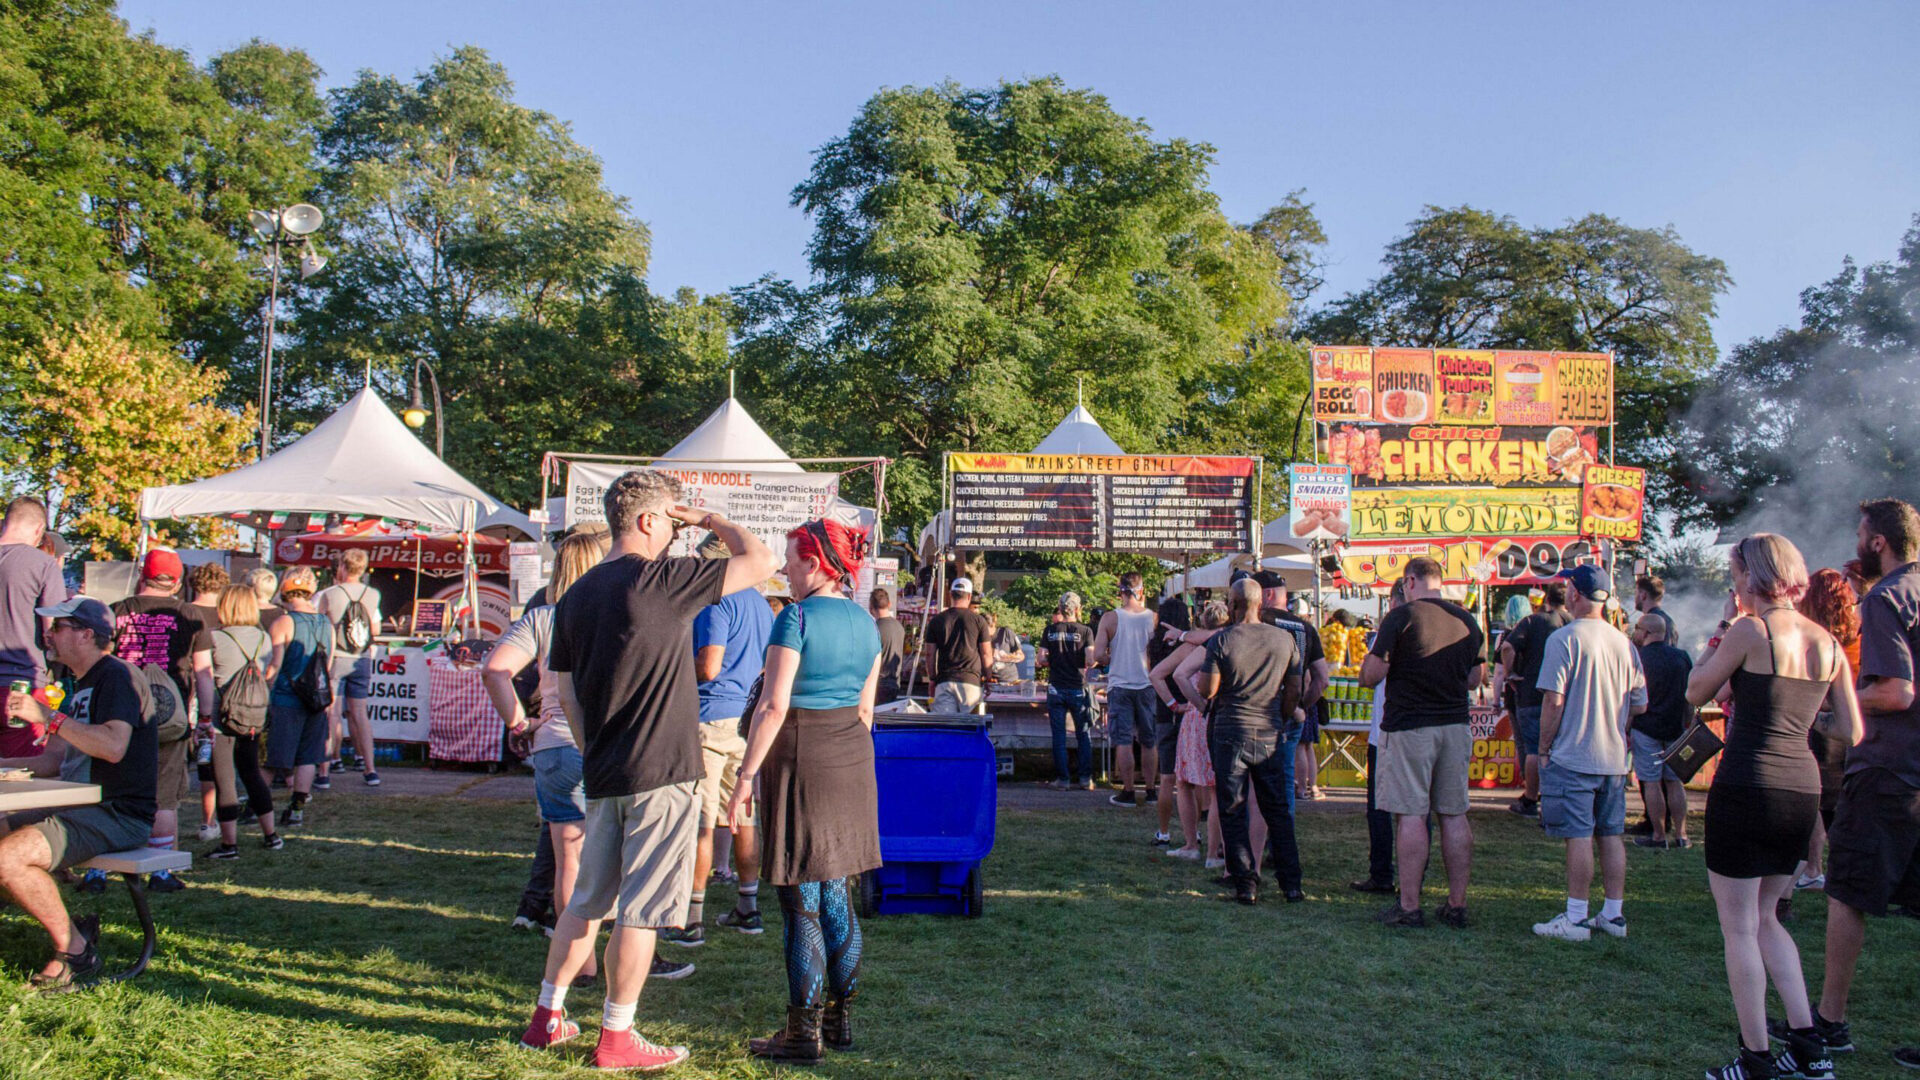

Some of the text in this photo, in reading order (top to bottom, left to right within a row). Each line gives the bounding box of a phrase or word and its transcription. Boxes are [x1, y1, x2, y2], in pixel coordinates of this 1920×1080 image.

[1437, 354, 1492, 377] Chicken
[1558, 358, 1608, 387] CHEESE
[1377, 370, 1432, 396] CHICKEN
[1437, 374, 1493, 396] Tenders
[1319, 387, 1353, 400] EGG
[1316, 401, 1357, 414] ROLL
[1496, 401, 1552, 413] CHEESE FRIES
[1558, 385, 1608, 421] FRIES
[1520, 413, 1549, 423] BACON
[1408, 426, 1503, 441] Grilled
[1026, 457, 1177, 471] MAINSTREET GRILL
[1380, 440, 1550, 476] CHICKEN
[1294, 466, 1348, 475] DEEP FRIED
[702, 471, 752, 487] NOODLE
[1071, 475, 1087, 483] SALAD
[1150, 477, 1170, 485] CHEESE
[1298, 475, 1344, 483] OREOS
[1586, 466, 1642, 492] CHEESE
[575, 485, 594, 496] Egg
[754, 483, 788, 493] Orange
[788, 484, 825, 494] Chicken
[1009, 488, 1024, 496] FRIES
[1296, 485, 1346, 495] SNICKERS
[575, 496, 594, 504] Pad
[728, 492, 753, 500] CHICKEN
[754, 493, 780, 501] TENDERS
[808, 495, 826, 504] $13
[956, 500, 969, 508] ALL
[994, 501, 1034, 509] CHEESEBURGER
[1043, 501, 1058, 509] FRIES
[1293, 496, 1348, 510] Twinkies
[727, 502, 756, 511] TERIYAKI
[808, 505, 826, 515] $13
[747, 514, 760, 522] And
[776, 514, 802, 523] Chicken
[996, 513, 1023, 521] SANDWICH
[1032, 514, 1047, 522] FRIES
[1354, 503, 1579, 537] LEMONADE
[976, 526, 1000, 534] SAUSAGE
[1009, 526, 1024, 534] FRIES
[1582, 515, 1639, 538] CURDS
[1011, 539, 1028, 547] STEAK
[311, 544, 492, 566] BaiPizza.cm
[481, 600, 511, 618] OWNED
[1468, 759, 1515, 784] dog
